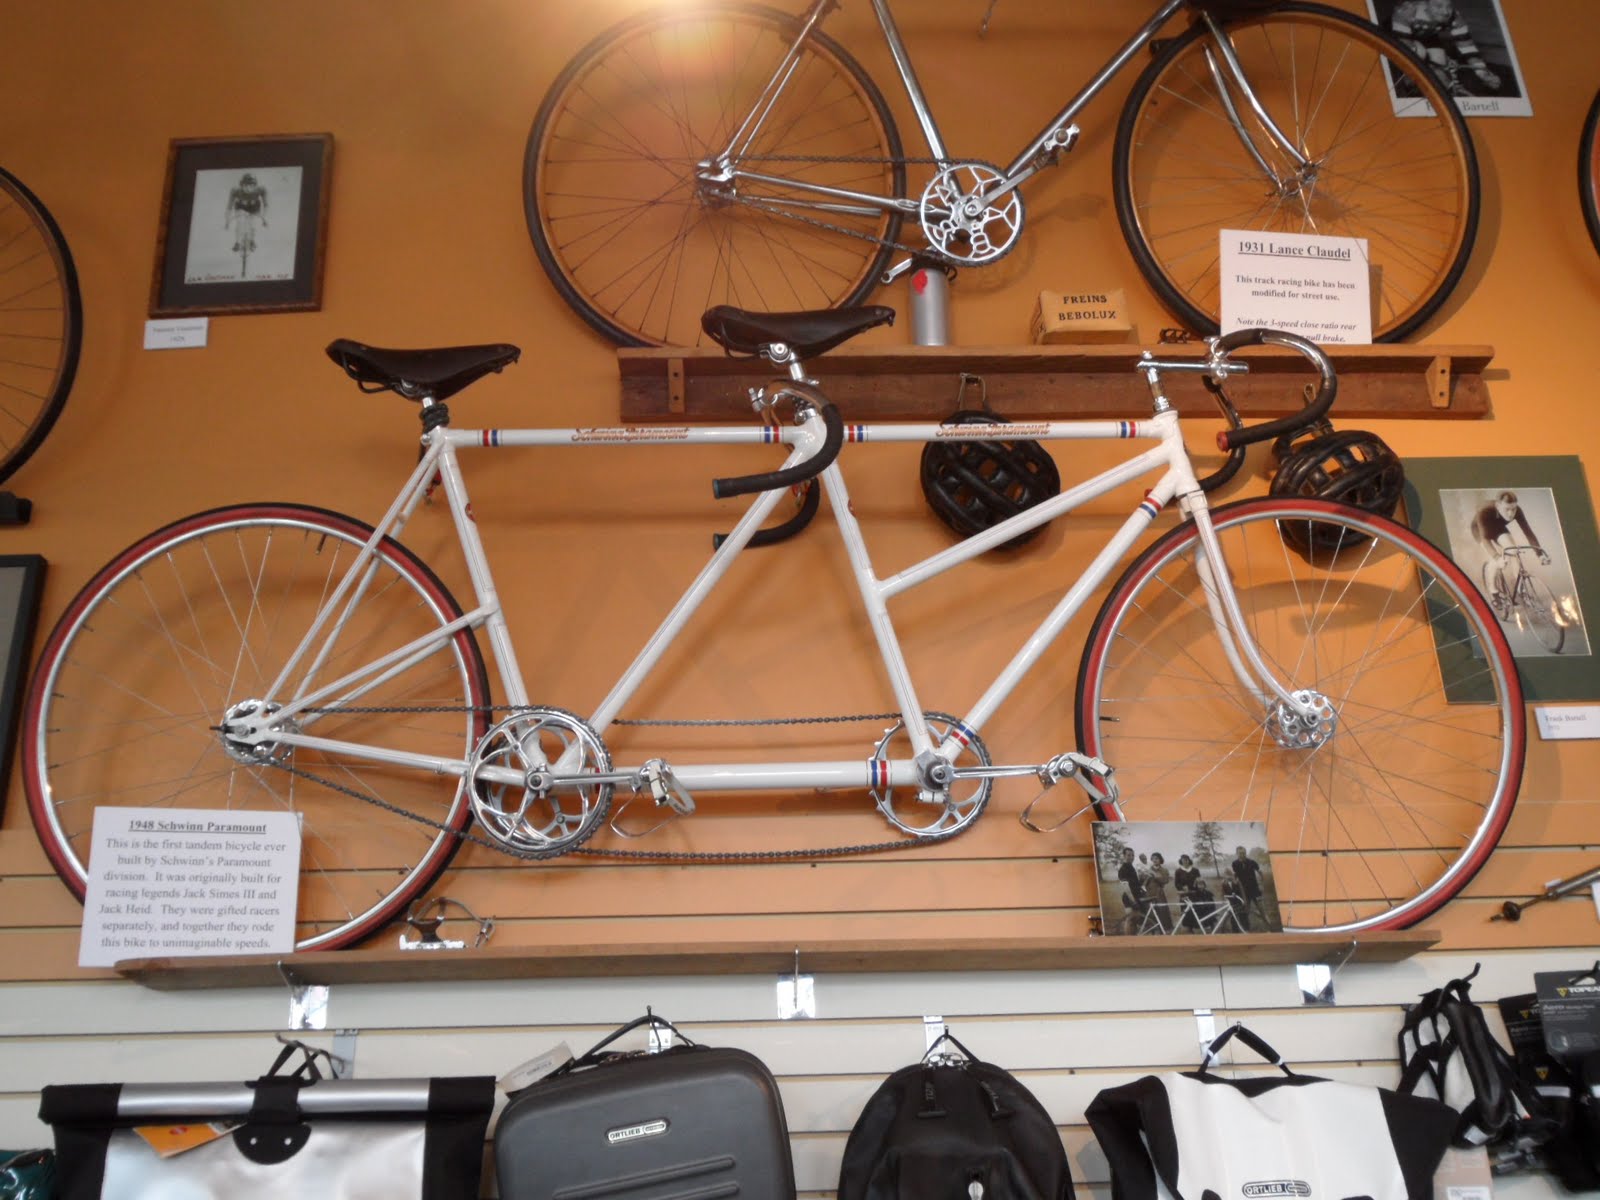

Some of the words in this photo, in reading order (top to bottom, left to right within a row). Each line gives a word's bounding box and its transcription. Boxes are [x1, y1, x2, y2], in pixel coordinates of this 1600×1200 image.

[1461, 101, 1500, 112] Bartell
[1239, 241, 1264, 254] 1931
[1269, 243, 1304, 256] Lance
[1307, 245, 1351, 259] Claudel
[1236, 275, 1252, 283] This
[1277, 278, 1302, 288] racing
[1304, 279, 1321, 287] bike
[1322, 280, 1336, 288] has
[1337, 281, 1356, 289] been
[1063, 295, 1107, 305] FREINS
[1251, 289, 1286, 298] modified
[1288, 290, 1300, 298] for
[1302, 292, 1323, 300] street
[1058, 310, 1116, 321] BEBOLUX
[1236, 317, 1254, 325] Note
[1256, 318, 1268, 326] the
[1271, 318, 1299, 328] 3-speed
[1300, 321, 1320, 329] close
[1340, 323, 1357, 331] rear
[128, 820, 154, 831] 1948
[158, 821, 203, 832] Schwinn
[207, 821, 267, 833] Paramount
[106, 838, 128, 849] This
[131, 838, 140, 849] is
[143, 839, 159, 849] the
[162, 839, 182, 849] first
[185, 840, 222, 850] tandem
[225, 841, 261, 853] bicycle
[264, 844, 286, 852] ever
[117, 855, 141, 865] built
[144, 855, 158, 867] by
[160, 856, 214, 866] Schwinn's
[217, 857, 271, 867] Paramount
[155, 872, 162, 881] It
[189, 873, 237, 885] originally
[241, 873, 264, 883] built
[267, 873, 282, 883] for
[105, 888, 138, 900] racing
[141, 888, 180, 900] legends
[183, 889, 206, 898] Jack
[209, 888, 240, 899] Simes
[243, 889, 255, 899] III
[258, 890, 276, 899] and
[99, 904, 122, 914] Jack
[161, 904, 186, 917] They
[190, 906, 214, 915] were
[217, 905, 247, 917] gifted
[249, 907, 280, 915] racers
[102, 921, 157, 933] separately,
[160, 921, 179, 931] and
[182, 922, 224, 934] together
[227, 922, 248, 934] they
[251, 923, 274, 932] rode
[101, 937, 120, 947] this
[124, 937, 146, 947] bike
[149, 939, 159, 947] to
[162, 938, 232, 950] unimaginable
[235, 939, 271, 950] speeds.
[609, 1127, 641, 1139] ORTLIEB
[1246, 1184, 1283, 1195] ORTLIEB
